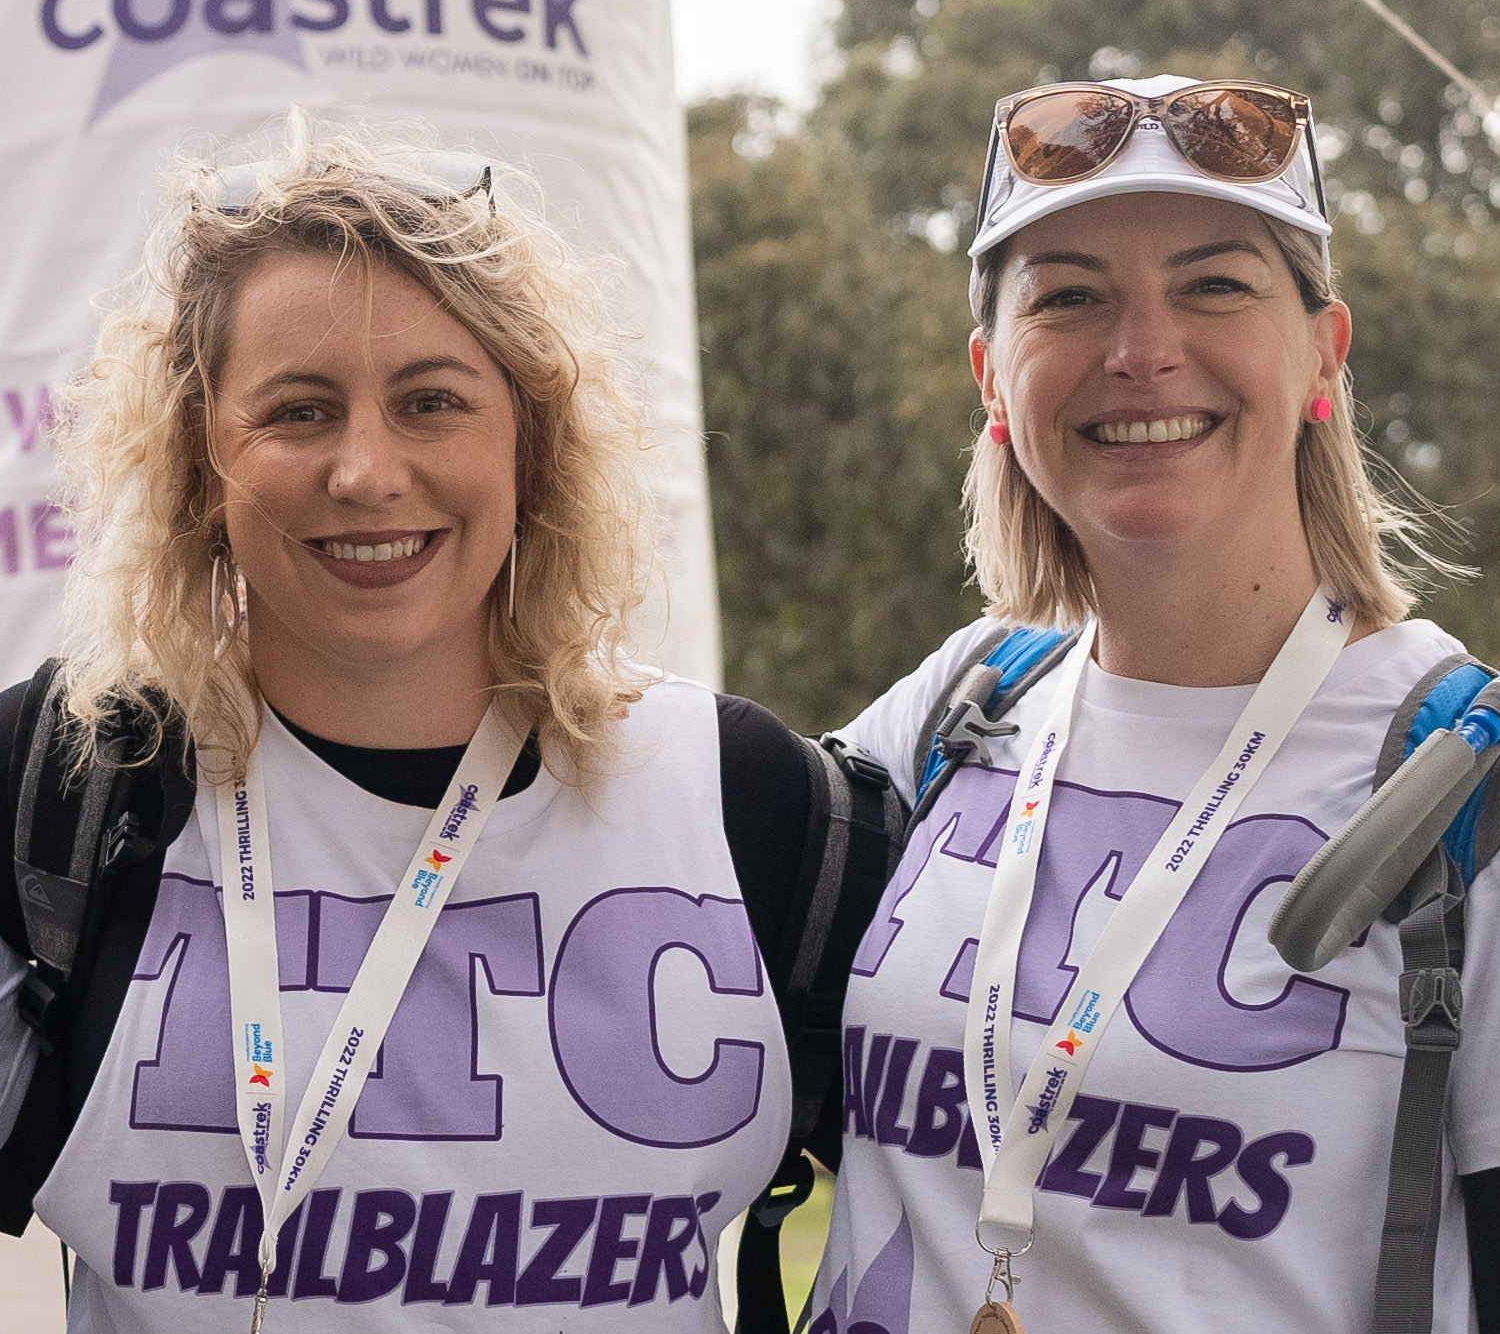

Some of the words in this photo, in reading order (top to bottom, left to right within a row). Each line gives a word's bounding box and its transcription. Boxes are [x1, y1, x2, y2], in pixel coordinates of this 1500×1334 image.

[442, 784, 478, 841] coastrek
[1165, 839, 1194, 873] 2022
[1187, 771, 1240, 837] THRILLING
[1233, 730, 1266, 771] 30KM
[235, 790, 252, 864] THRILLING
[241, 866, 255, 900] 2022
[412, 869, 427, 889] Blue
[415, 872, 438, 907] Beyond
[131, 873, 765, 1148] TTC
[985, 984, 1000, 1023] 2022
[1072, 992, 1100, 1030] Beyond
[1082, 1011, 1100, 1033] Blue
[251, 1024, 261, 1062] Beyond
[263, 1040, 272, 1063] Blue
[339, 1027, 363, 1065] 2022
[983, 1024, 998, 1112] THRILLING
[304, 1067, 348, 1146] THRILLING
[1028, 1067, 1065, 1135] coastrek
[252, 1102, 268, 1175] coastrek
[284, 1146, 311, 1191] 30KM
[109, 1181, 722, 1308] TRAILBLAZERS
